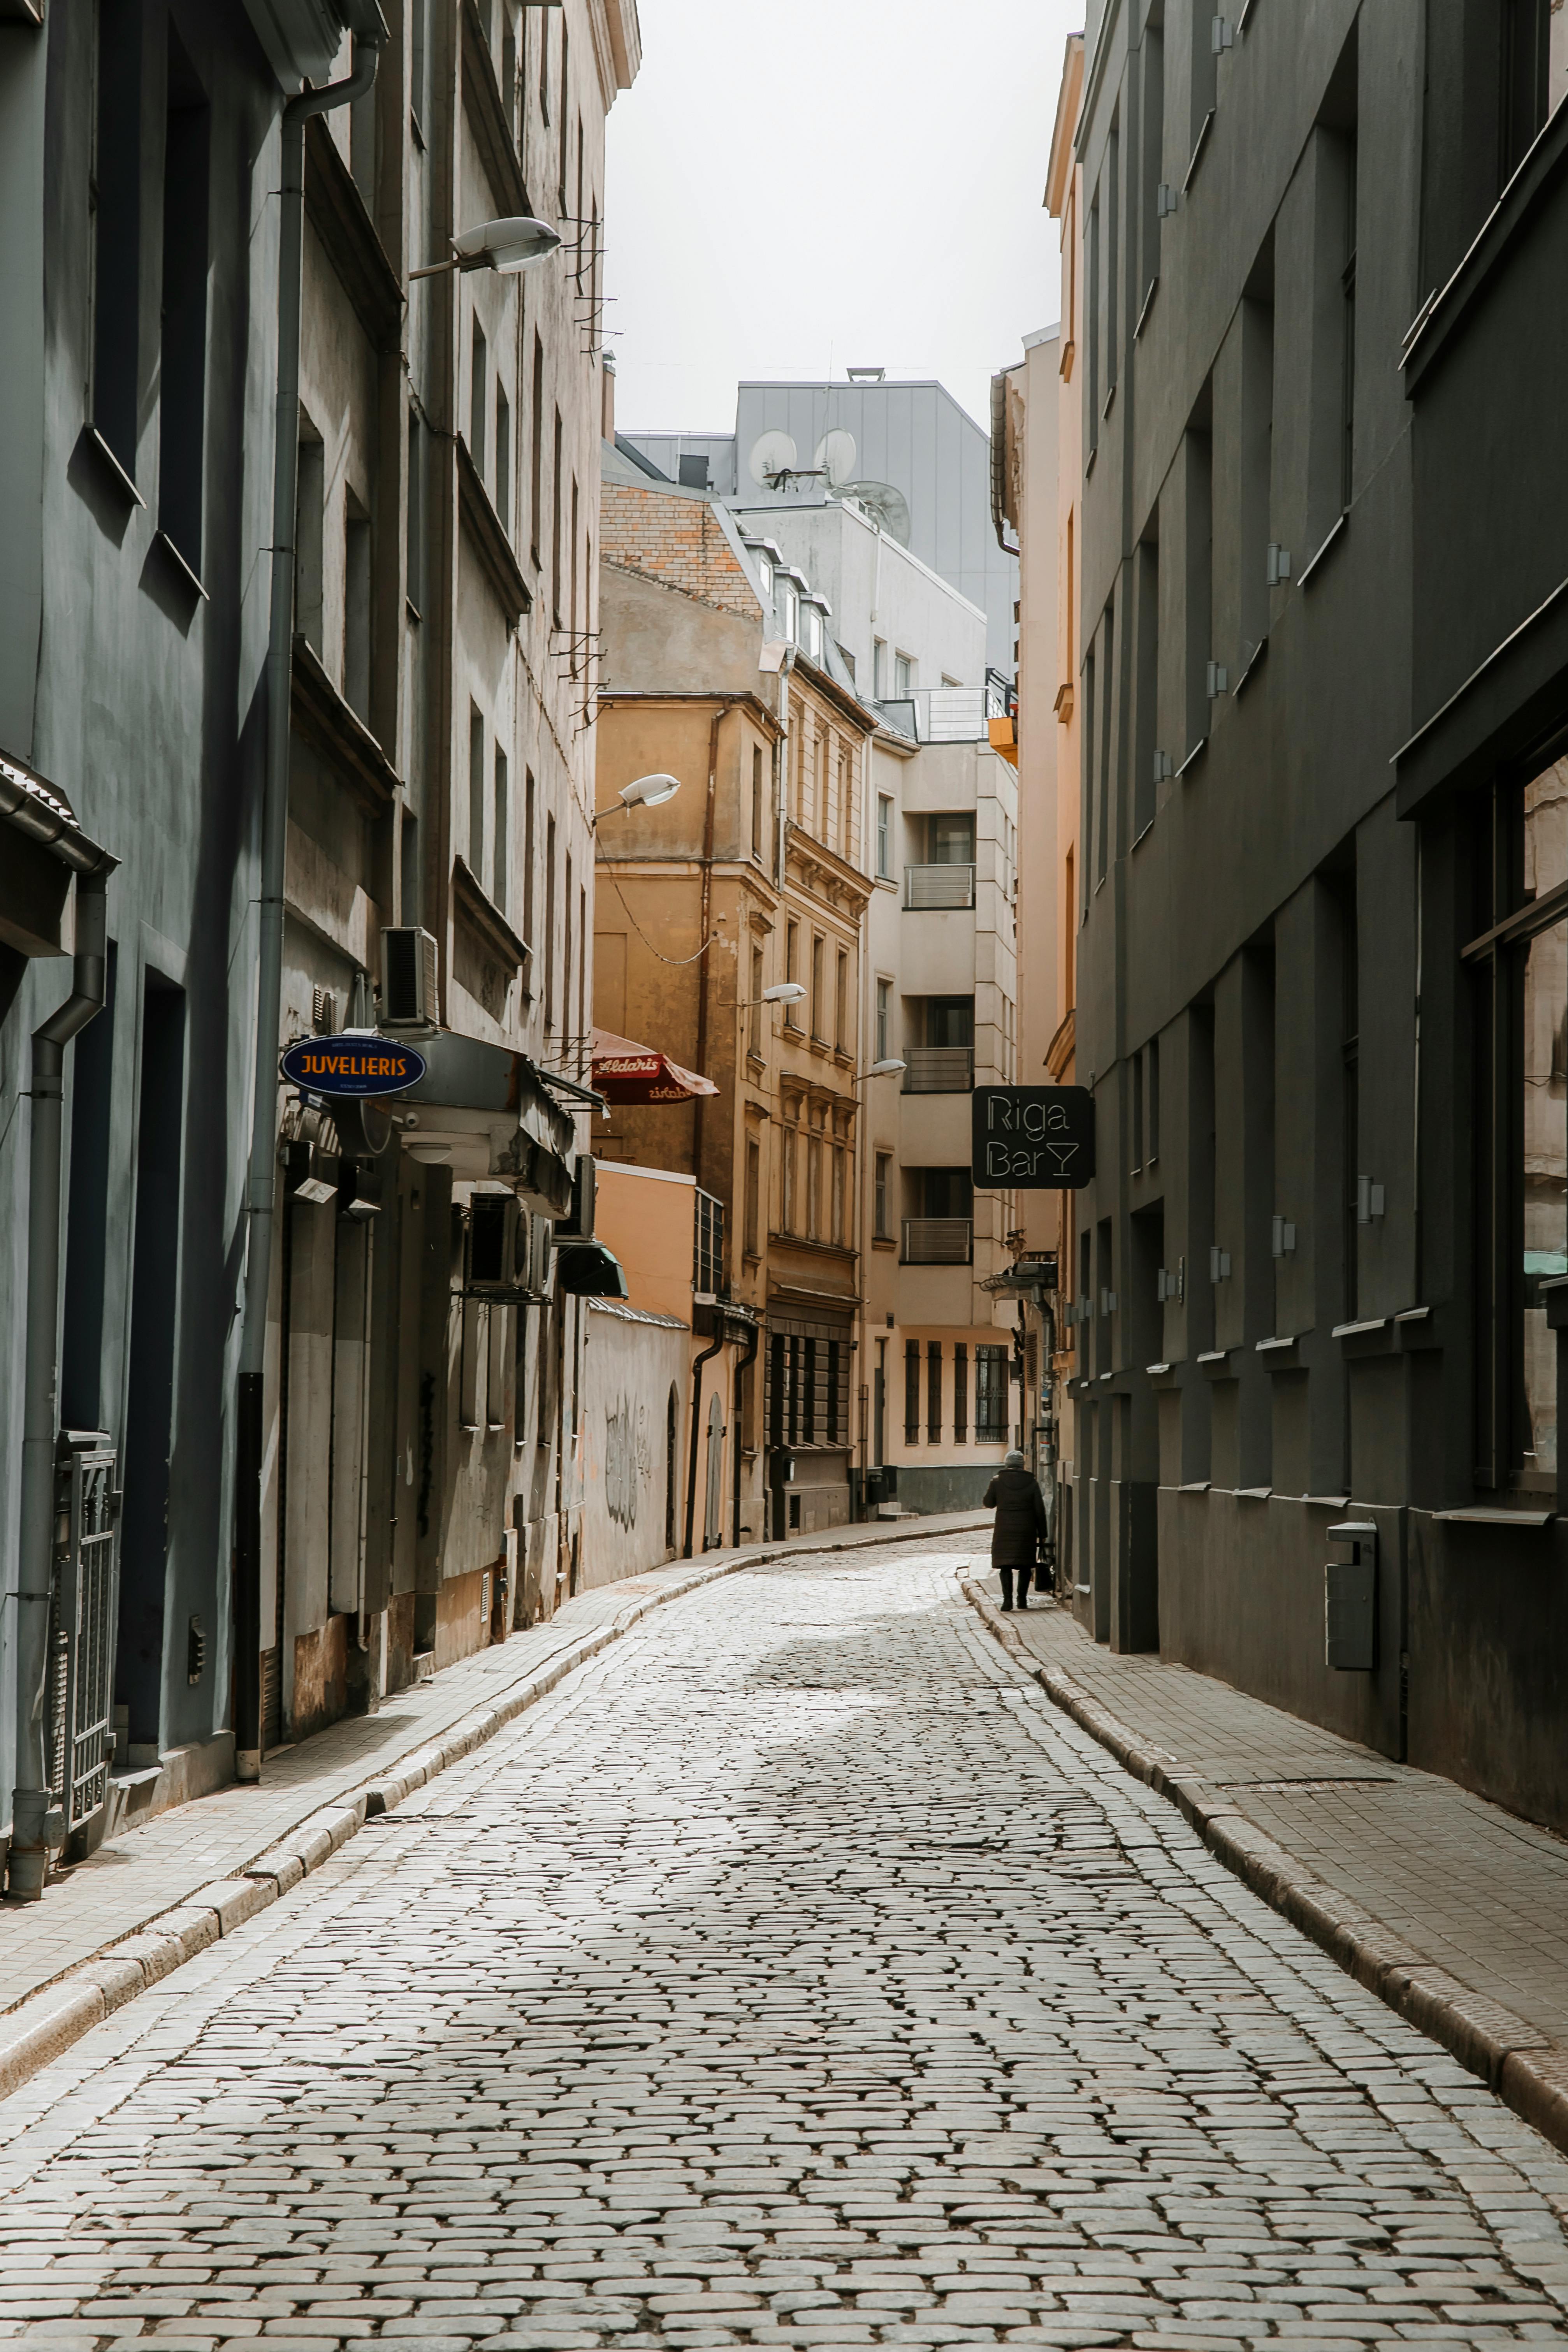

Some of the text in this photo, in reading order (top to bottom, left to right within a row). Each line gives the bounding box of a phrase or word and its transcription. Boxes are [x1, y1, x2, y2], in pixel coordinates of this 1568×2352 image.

[301, 1055, 406, 1076] JUVELIERIS
[595, 1058, 659, 1075] Aldaris
[988, 1096, 1071, 1141] Riga
[986, 1141, 1045, 1176] Bar
